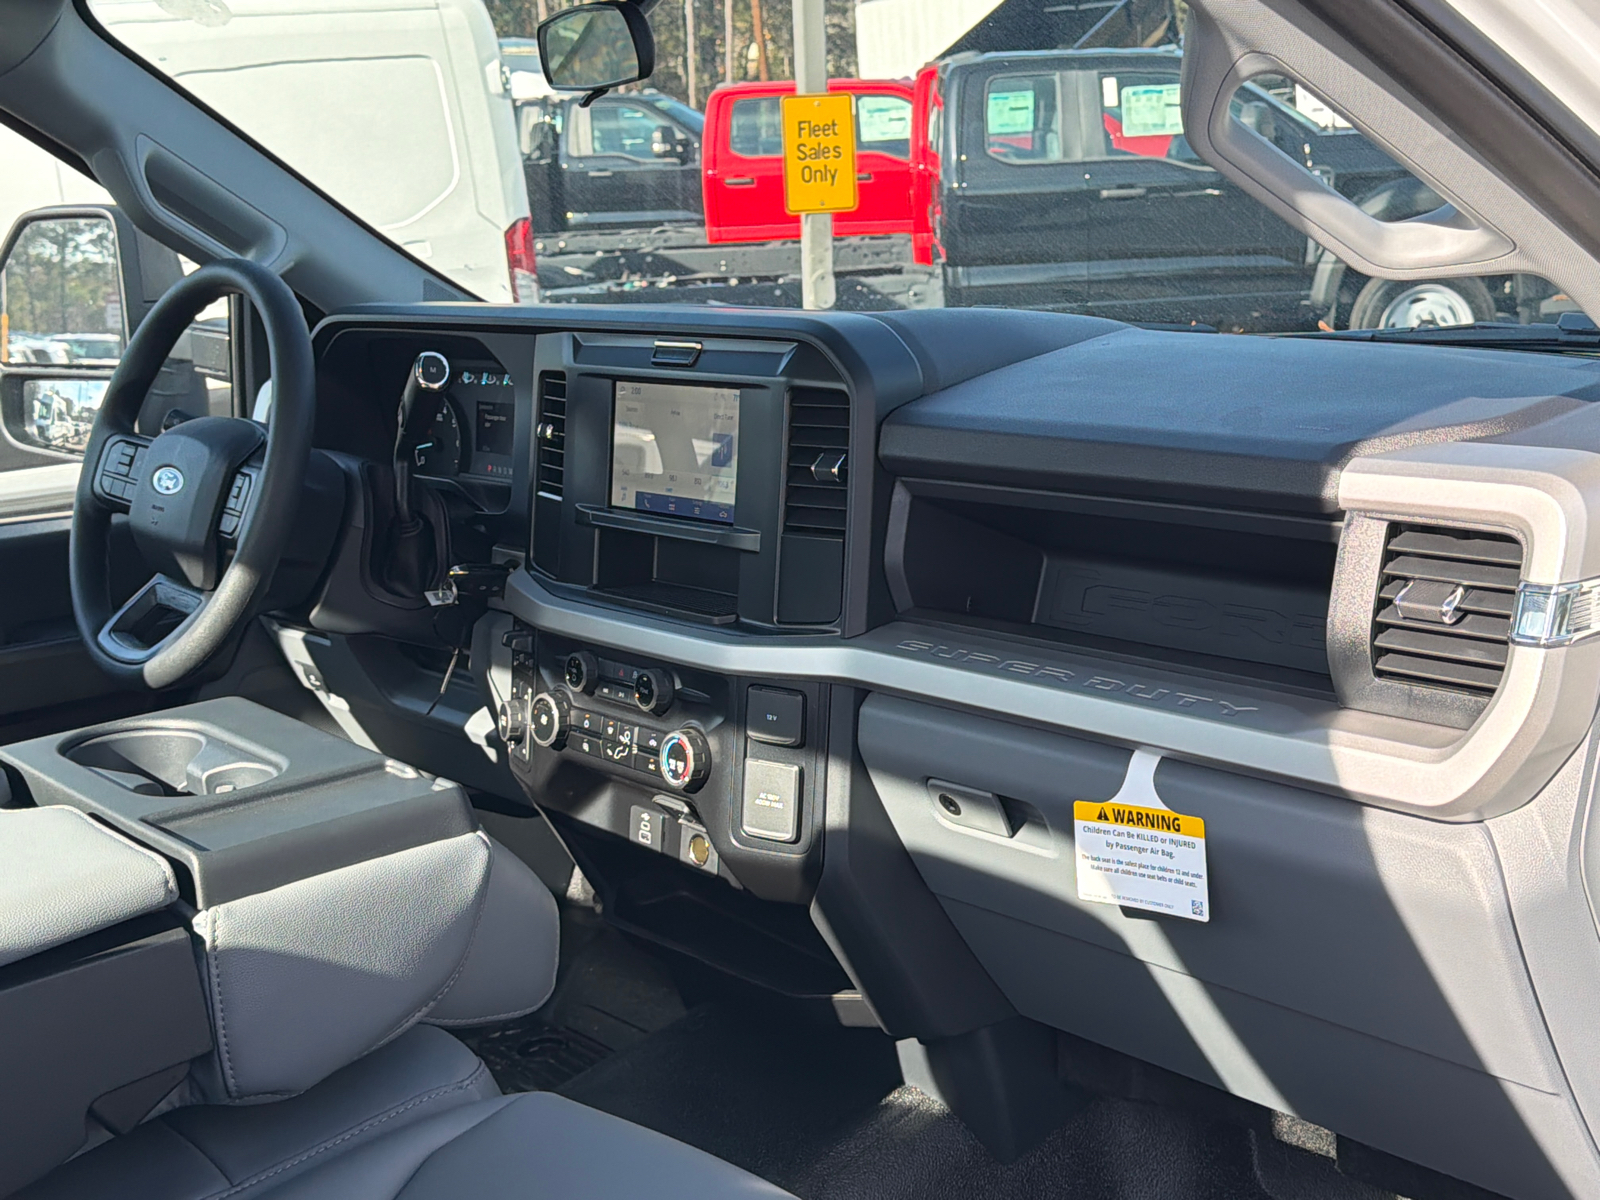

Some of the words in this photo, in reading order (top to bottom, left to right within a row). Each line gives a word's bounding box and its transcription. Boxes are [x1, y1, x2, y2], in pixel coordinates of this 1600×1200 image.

[797, 118, 839, 139] Fleet
[796, 142, 842, 161] Sales
[801, 164, 838, 187] Only
[896, 640, 1076, 682] SUPER
[1083, 676, 1259, 716] DUTY
[1111, 807, 1181, 833] WARNING
[1082, 825, 1111, 836] Children
[1112, 829, 1126, 838] Can
[1126, 831, 1135, 839] Be
[1136, 832, 1159, 844] KILLED
[1160, 837, 1167, 845] or
[1168, 837, 1196, 850] INJURED
[1105, 839, 1114, 850] by
[1115, 841, 1148, 855] Passenger
[1149, 846, 1160, 856] Air
[1161, 848, 1176, 860] Bag.
[1157, 865, 1175, 874] children
